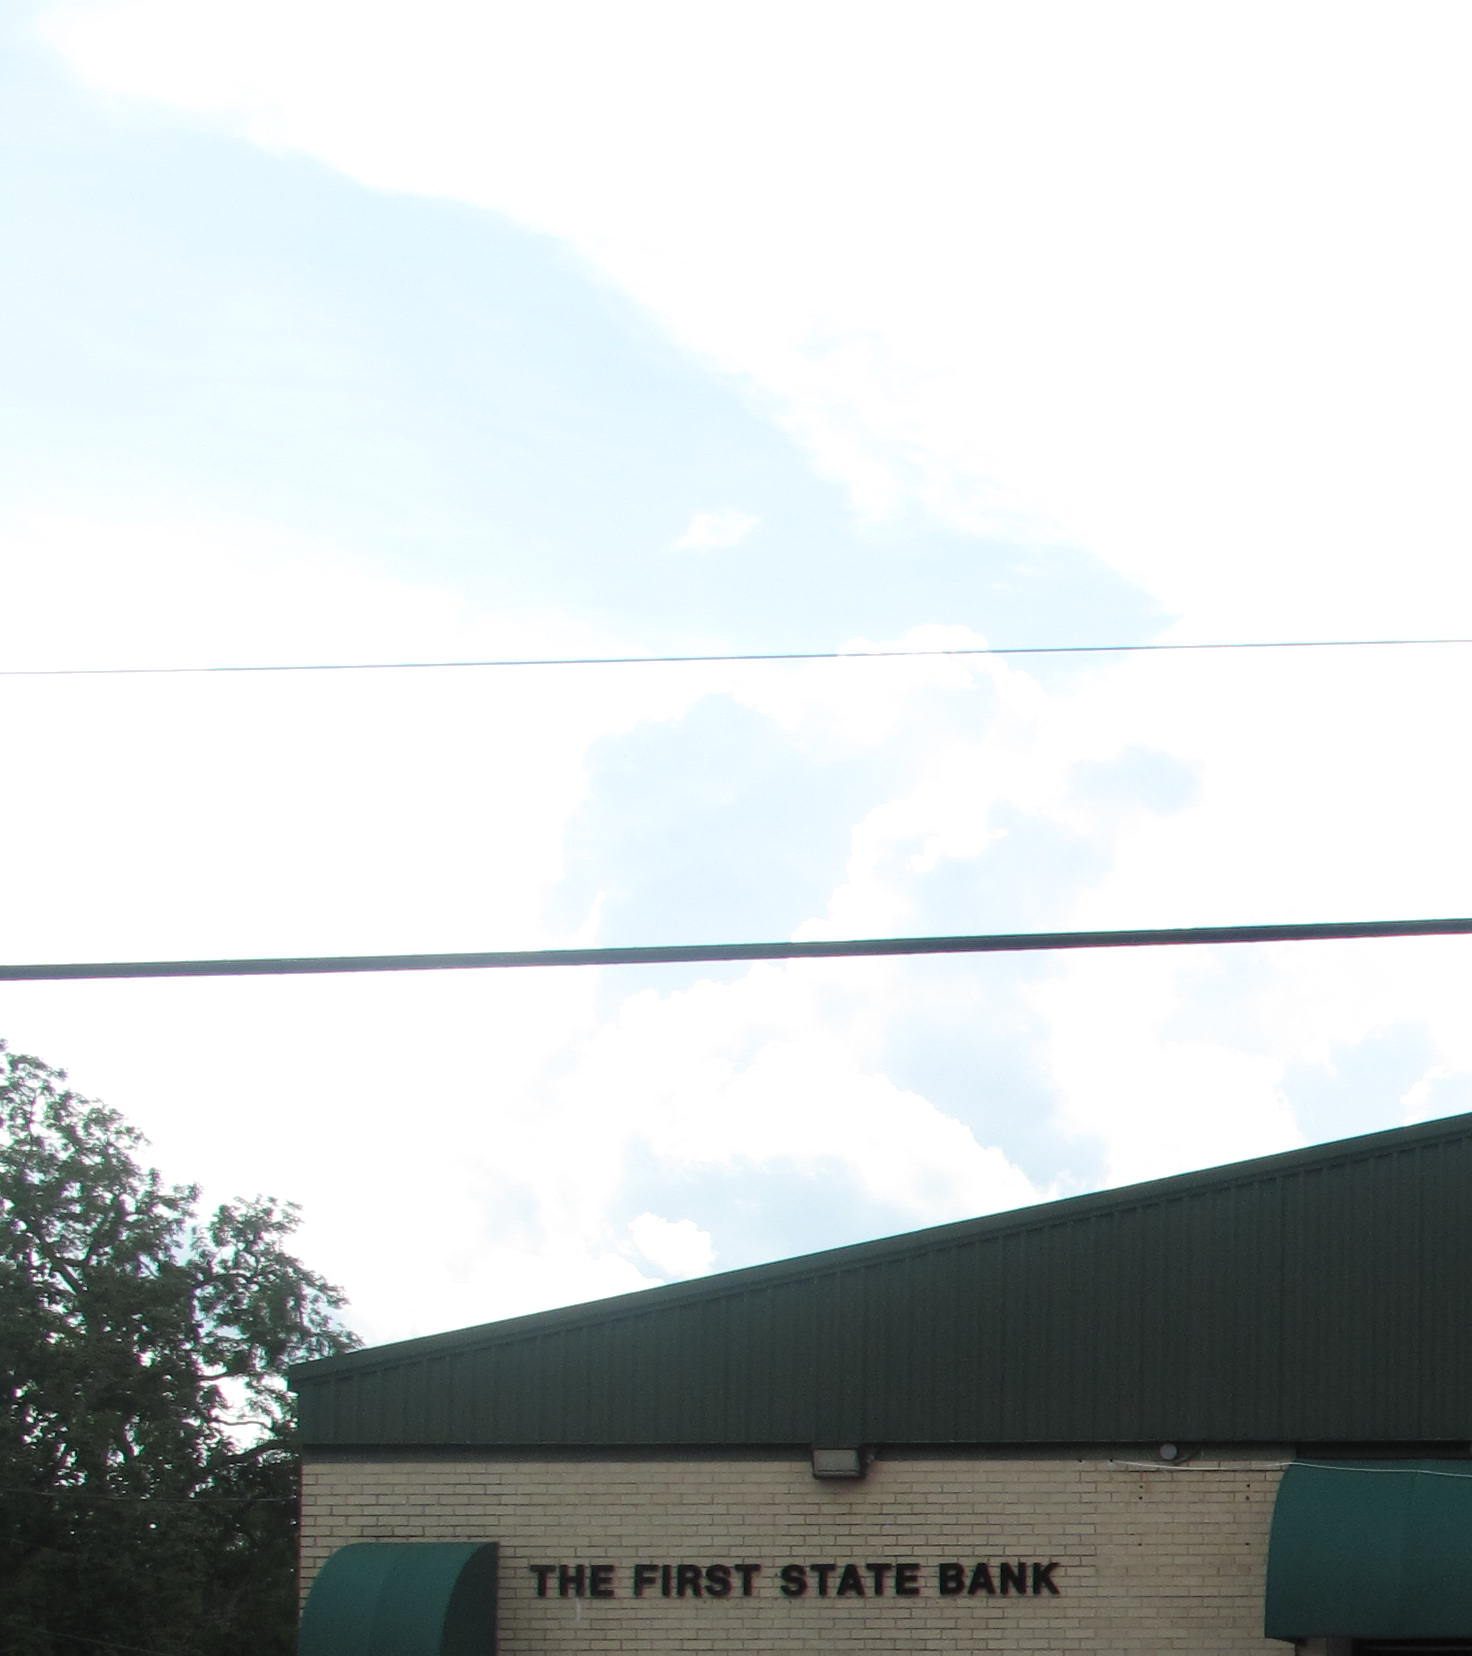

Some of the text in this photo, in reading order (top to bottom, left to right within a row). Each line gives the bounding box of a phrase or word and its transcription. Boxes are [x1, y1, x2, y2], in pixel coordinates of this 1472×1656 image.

[530, 1561, 1060, 1598] THE FIRST STATE BANK
